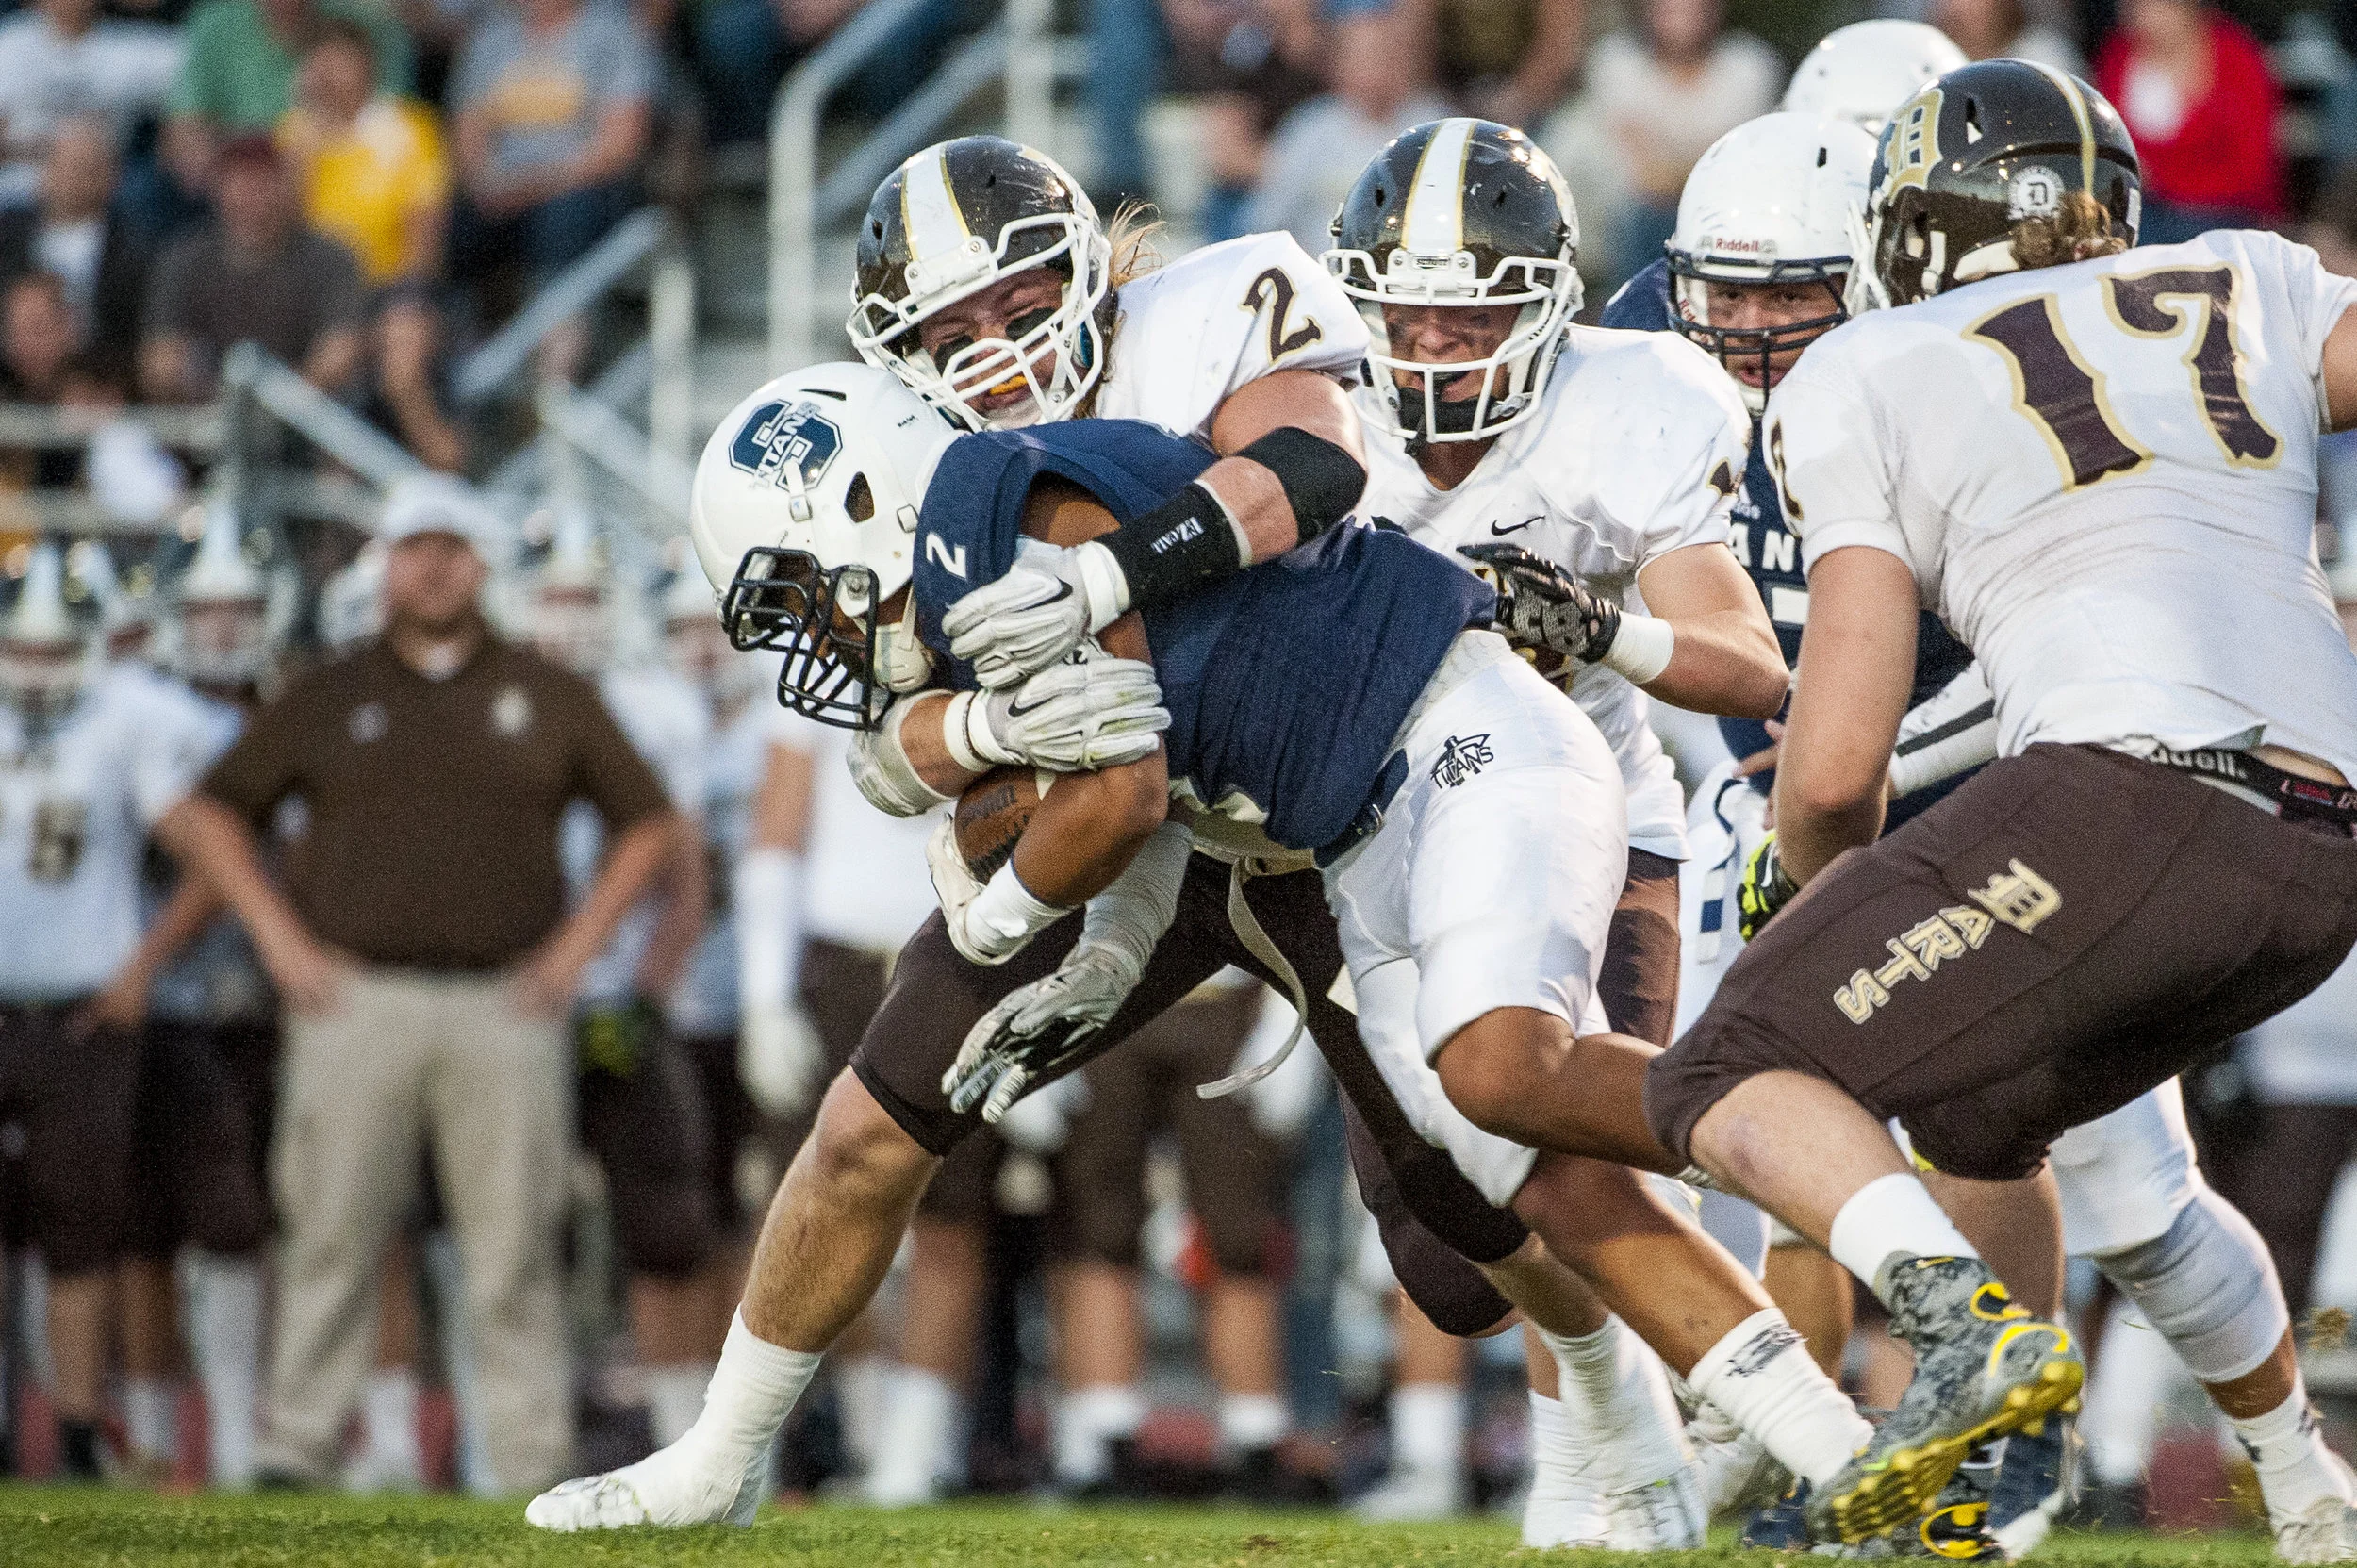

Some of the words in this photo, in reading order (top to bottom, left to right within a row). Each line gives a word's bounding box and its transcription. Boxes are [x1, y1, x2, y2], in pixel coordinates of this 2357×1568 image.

[1715, 237, 1759, 252] Riddell
[1240, 263, 1322, 365] 2
[1960, 260, 2285, 494] 17
[926, 531, 967, 581] 2
[1429, 746, 1494, 789] TITANS
[1833, 857, 2063, 1025] DARTS
